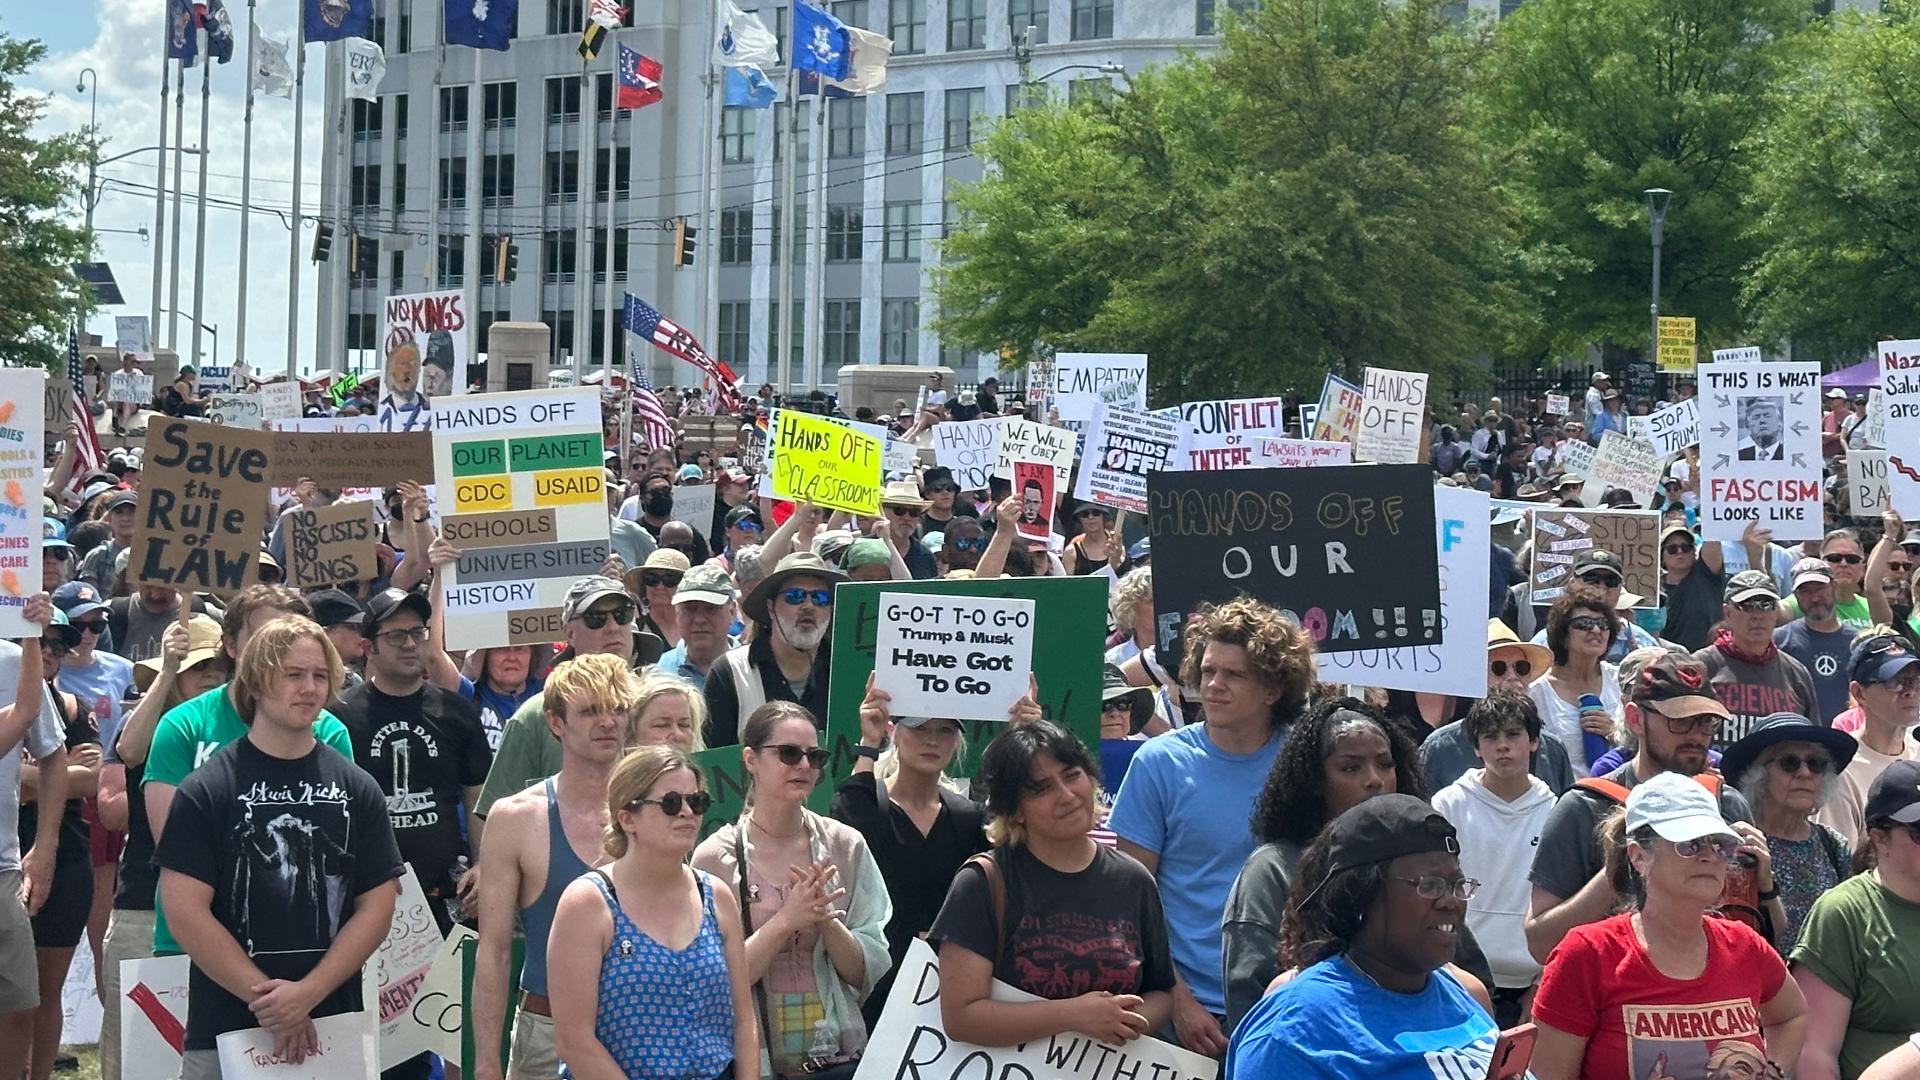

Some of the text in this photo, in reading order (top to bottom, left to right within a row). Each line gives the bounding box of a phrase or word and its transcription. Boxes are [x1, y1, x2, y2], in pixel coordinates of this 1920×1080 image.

[386, 296, 465, 332] NO KINGS
[200, 366, 230, 378] ACLU
[1706, 371, 1819, 389] THIS IS WHAT
[1363, 370, 1425, 406] HANDS
[435, 402, 577, 429] HANDS OFF
[1363, 405, 1419, 436] OFF
[1889, 402, 1920, 418] are
[781, 416, 831, 452] HANDS
[840, 432, 876, 467] OFF
[1007, 422, 1067, 450] WE WILL
[1109, 433, 1167, 458] HANDS
[1226, 435, 1243, 445] OF
[153, 422, 268, 483] Save
[454, 439, 591, 467] OUR PLANET
[1002, 441, 1059, 461] NOT OBEY
[1261, 440, 1308, 458] LAWSUITS
[818, 459, 838, 473] OUR
[1018, 464, 1027, 477] I
[1030, 465, 1045, 479] AM
[184, 480, 221, 500] the
[457, 475, 600, 503] CDC USAID
[1710, 478, 1819, 502] FASCISM
[145, 488, 245, 534] Rule
[292, 510, 317, 527] NO
[1151, 488, 1404, 537] HANDS OFF
[1712, 506, 1805, 521] LOOKS LIKE
[183, 533, 208, 547] of
[292, 518, 369, 548] FASCISTS
[444, 515, 550, 541] SCHOOLS
[1593, 515, 1656, 541] STOP
[1, 555, 29, 568] CARE
[138, 536, 250, 590] LAW
[293, 547, 318, 564] NO
[295, 556, 359, 583] KINGS
[446, 582, 536, 607] HISTORY
[510, 614, 562, 635] SCIE
[887, 604, 1029, 628] G-O-T T-O G-O
[899, 627, 1015, 645] Trump & Musk
[892, 648, 1013, 671] Have Got
[916, 674, 991, 695] To Go
[370, 720, 411, 758] BETTER
[412, 724, 439, 758] DAYS
